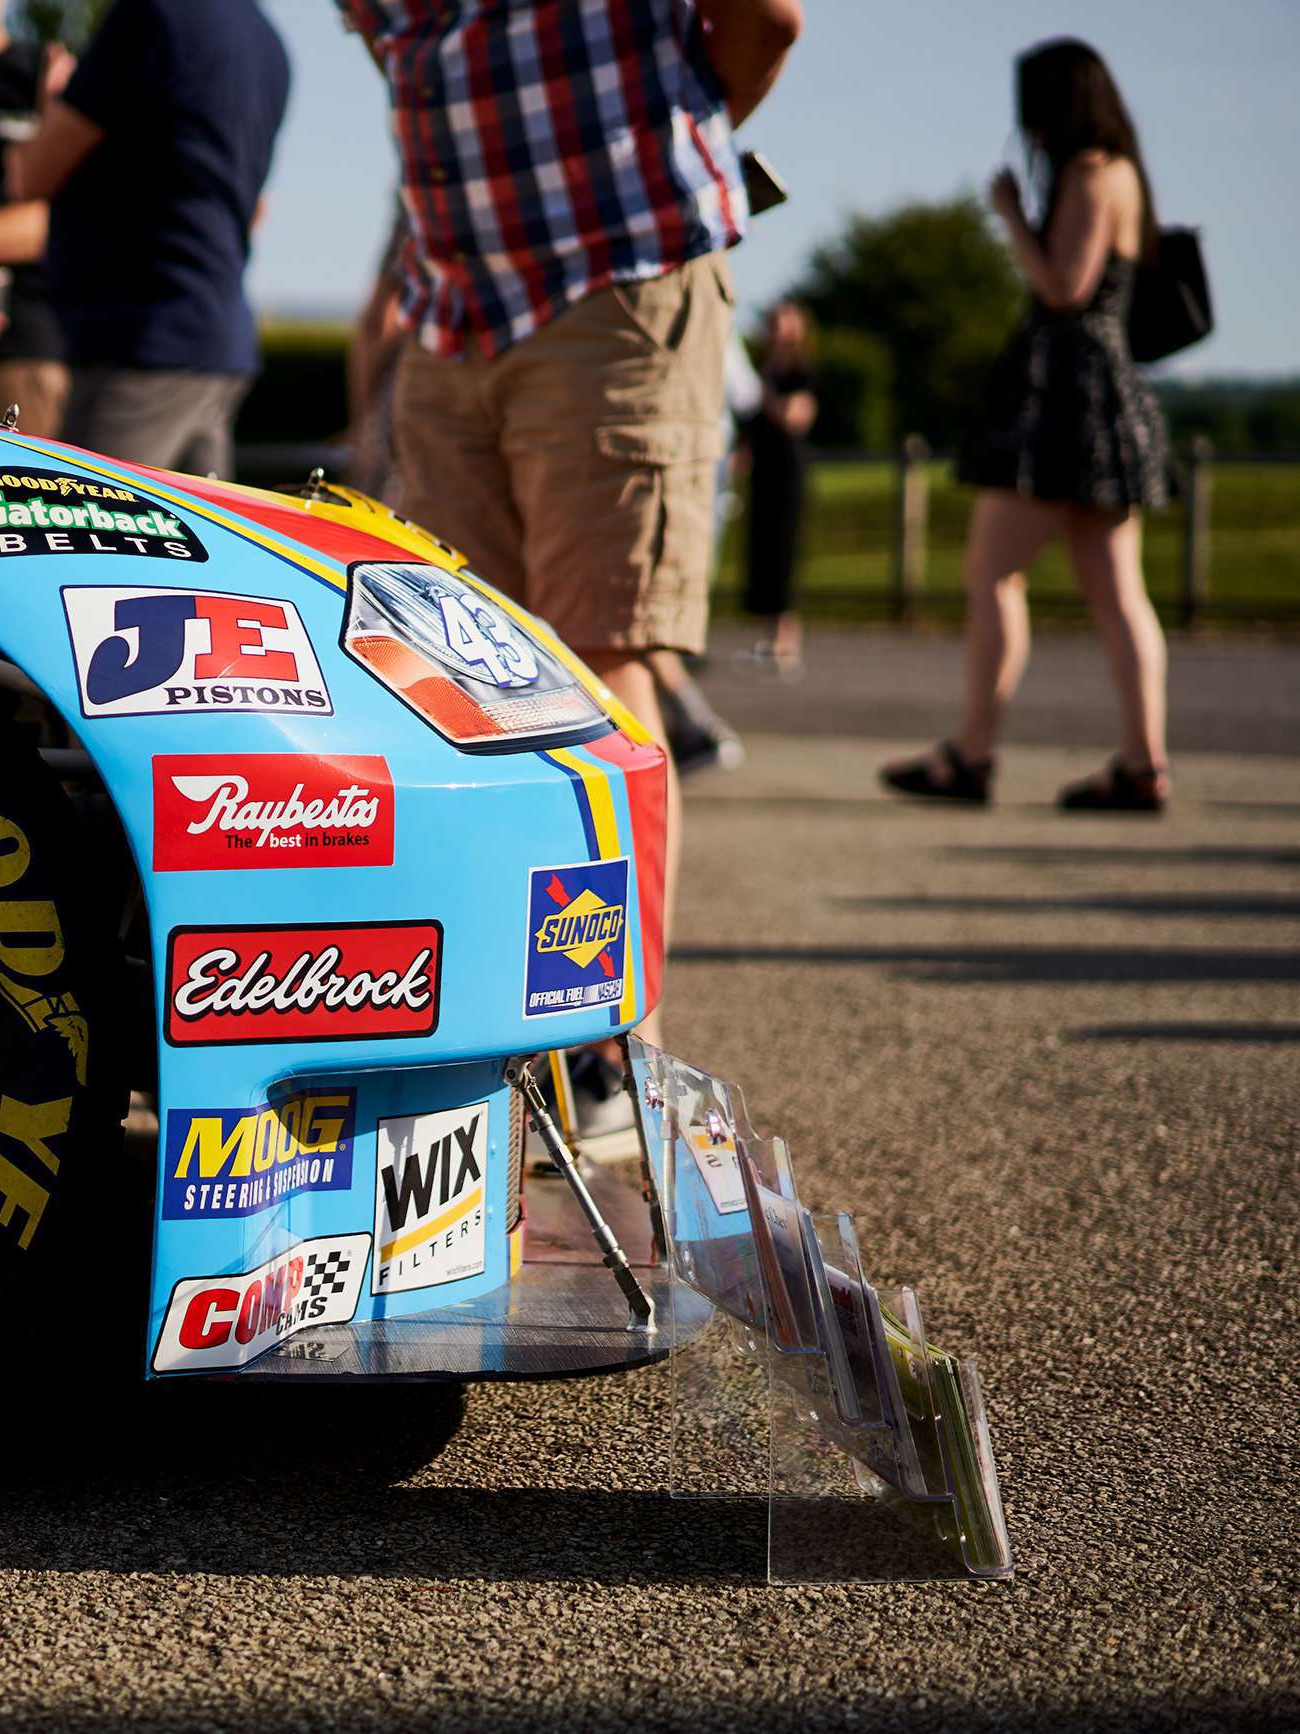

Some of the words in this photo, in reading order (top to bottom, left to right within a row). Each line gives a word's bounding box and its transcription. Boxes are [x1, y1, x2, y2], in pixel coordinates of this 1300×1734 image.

[86, 595, 300, 706] JE
[438, 593, 540, 689] 43
[164, 686, 327, 708] PISTONS
[171, 774, 380, 848] Raybestos
[225, 834, 252, 849] The
[269, 833, 302, 848] best
[305, 833, 319, 847] in
[323, 832, 370, 847] brakes
[540, 908, 621, 949] SUNOCO
[174, 945, 431, 1017] Edelbrock
[173, 1095, 350, 1179] MOOG
[380, 1113, 481, 1233] WIX
[183, 1178, 264, 1210] STEERING
[273, 1158, 335, 1198] SUSPENSION
[379, 1209, 481, 1286] FILTERS
[178, 1255, 304, 1350] COMP
[275, 1296, 328, 1336] CAMS
